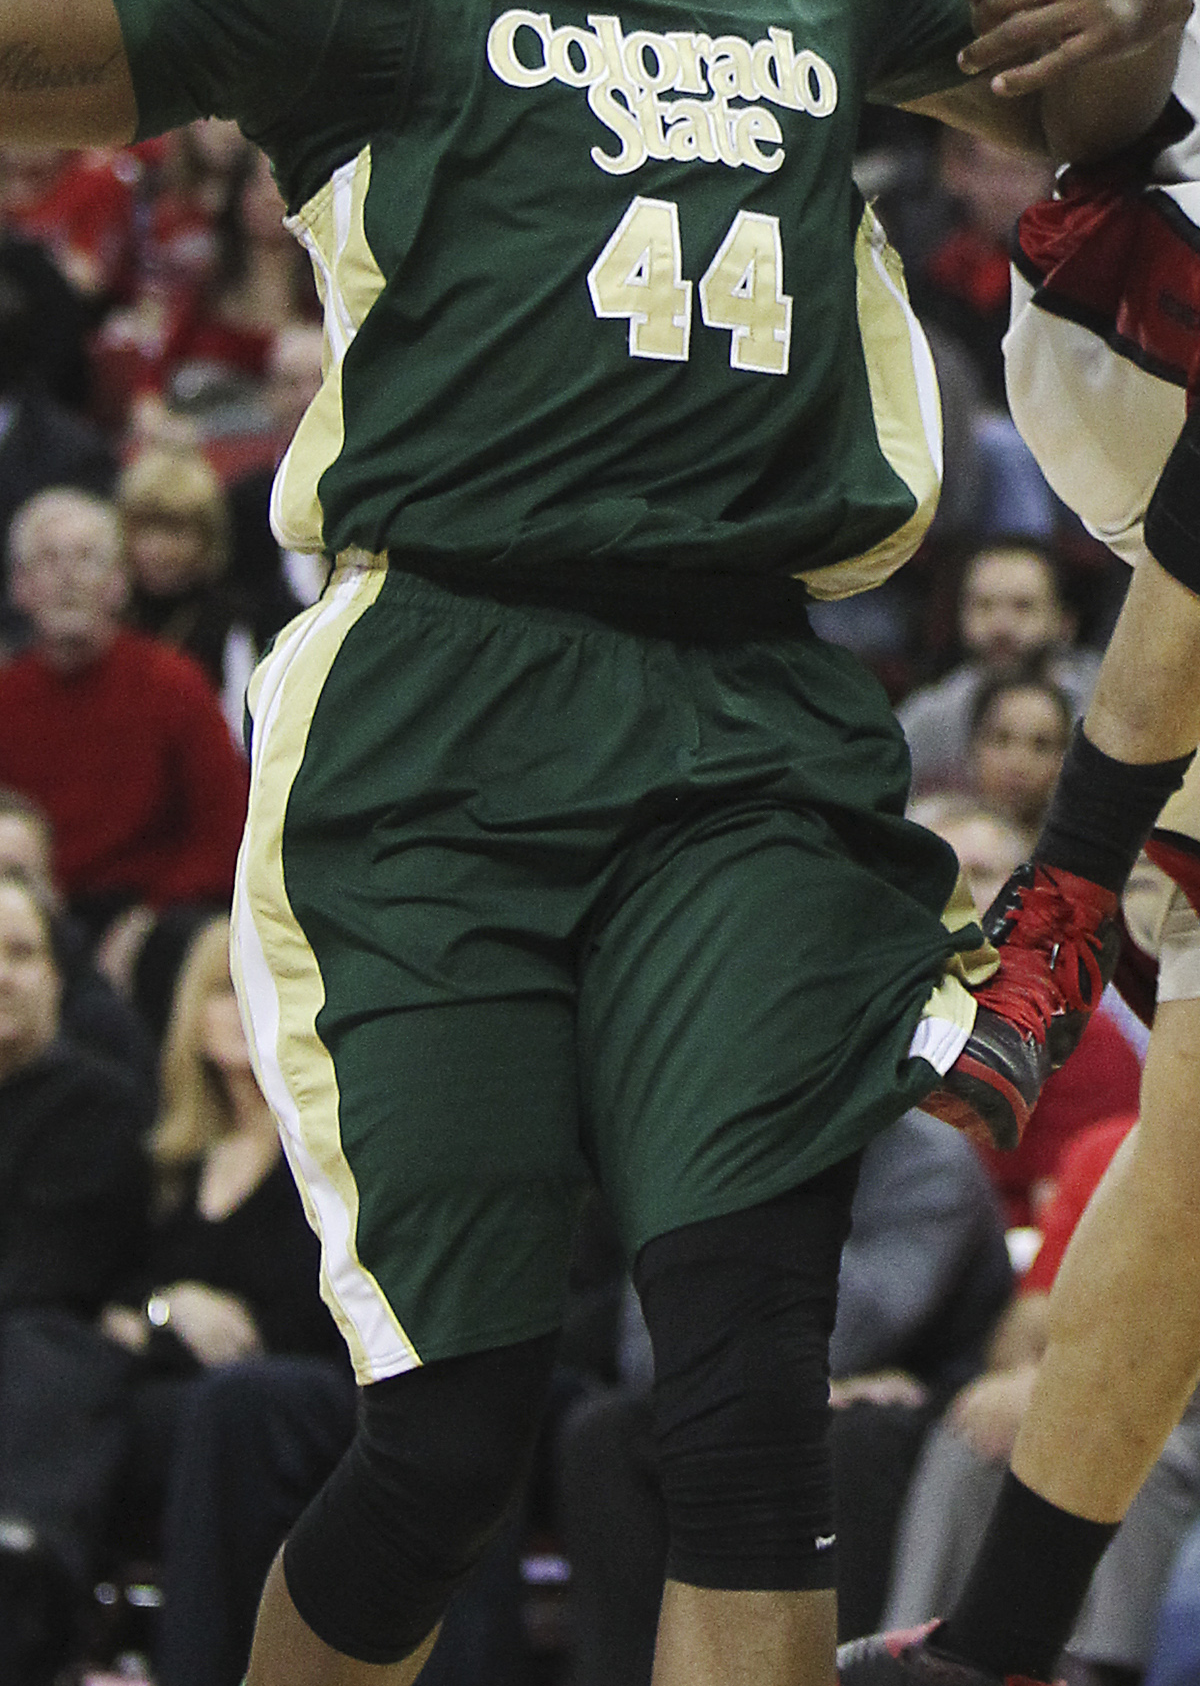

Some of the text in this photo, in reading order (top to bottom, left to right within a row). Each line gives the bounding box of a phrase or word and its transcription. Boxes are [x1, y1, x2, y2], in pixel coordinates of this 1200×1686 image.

[487, 9, 838, 118] Colorado
[587, 76, 785, 175] State
[586, 195, 793, 375] 44
